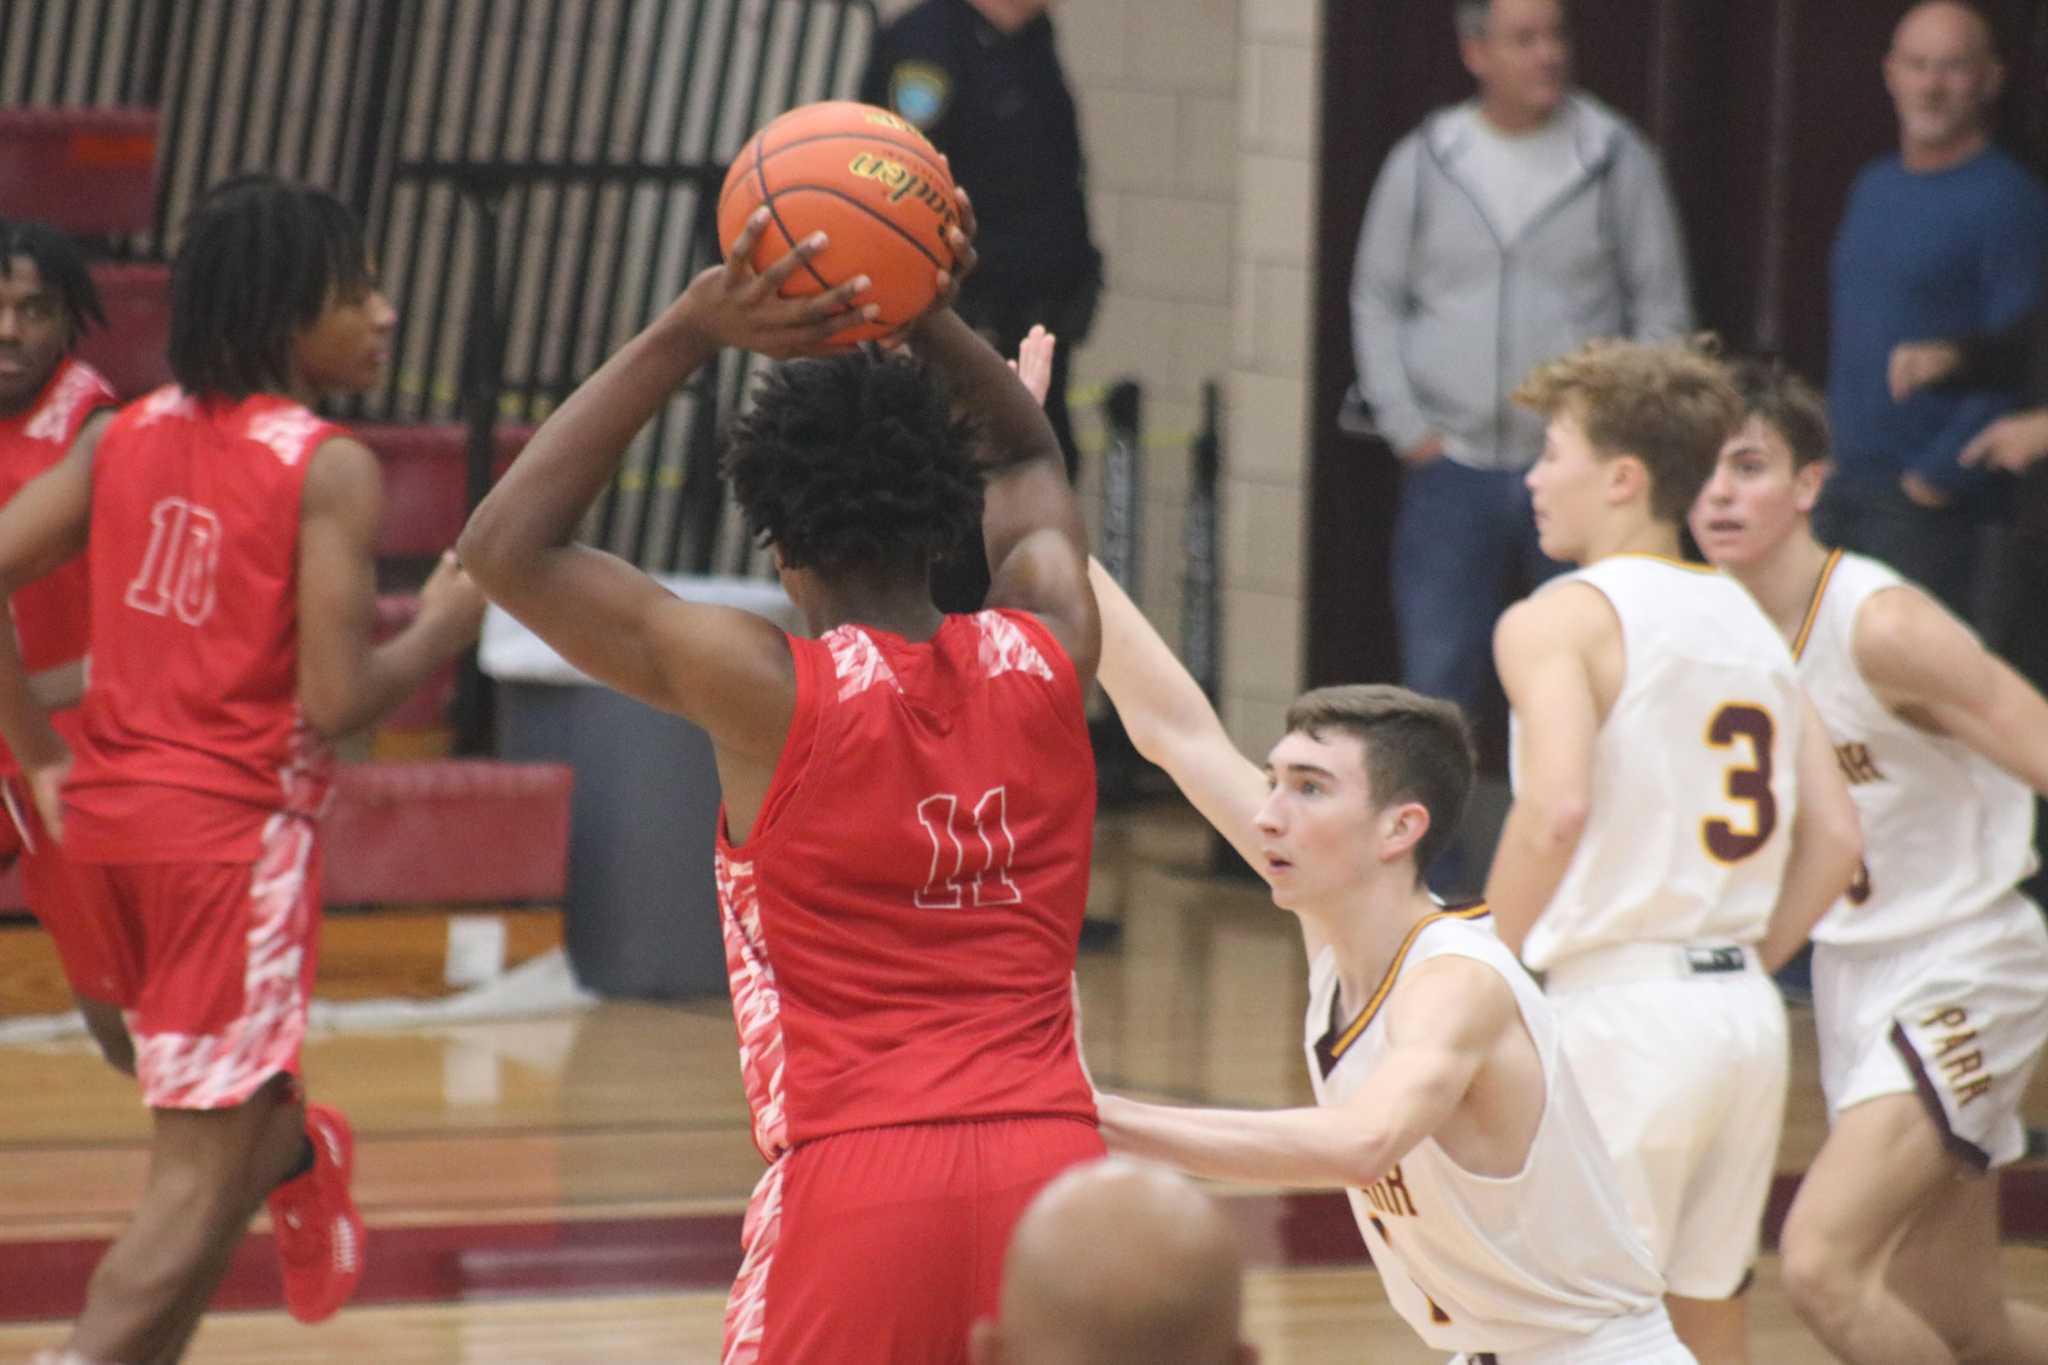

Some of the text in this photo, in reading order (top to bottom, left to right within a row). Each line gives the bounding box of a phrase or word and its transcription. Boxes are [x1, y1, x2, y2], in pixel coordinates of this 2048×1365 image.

[124, 496, 222, 626] 10
[1700, 701, 1777, 866] 3
[914, 786, 1022, 908] 11
[1919, 1006, 1993, 1107] PARK
